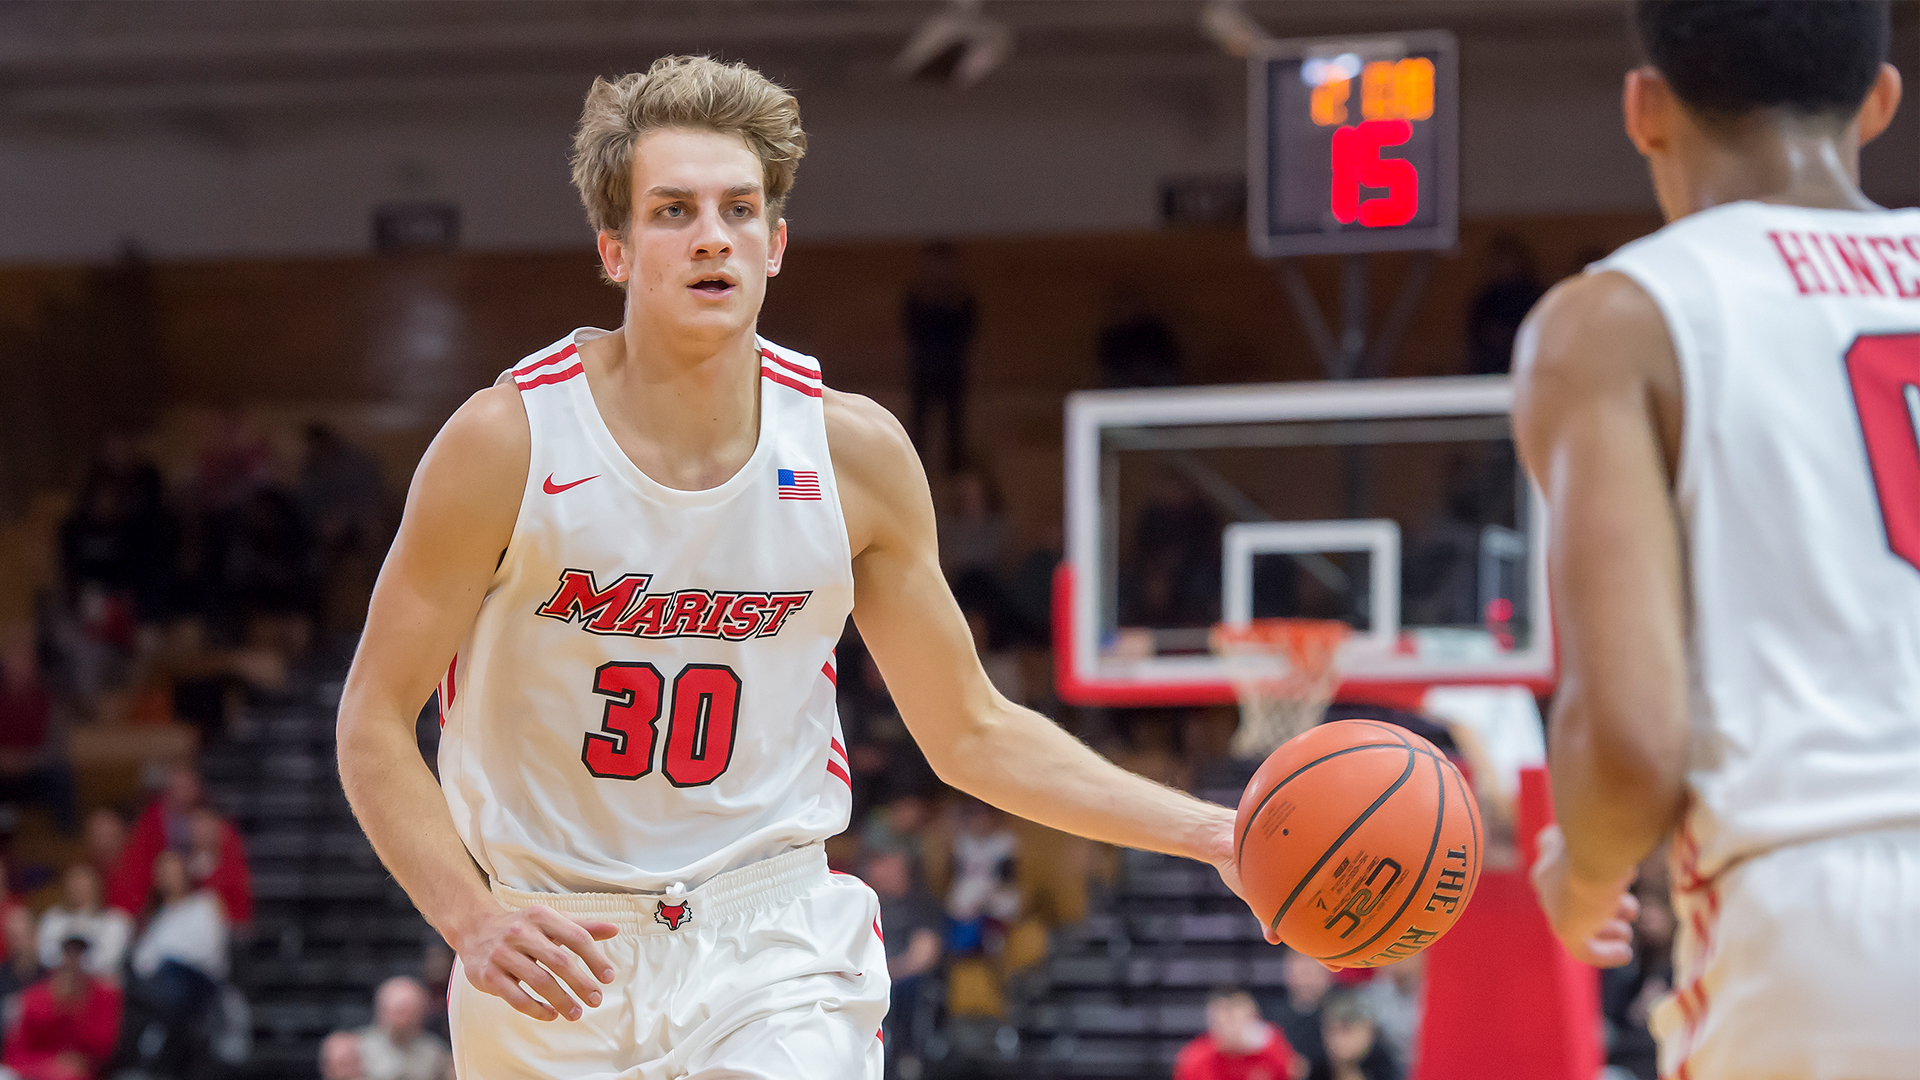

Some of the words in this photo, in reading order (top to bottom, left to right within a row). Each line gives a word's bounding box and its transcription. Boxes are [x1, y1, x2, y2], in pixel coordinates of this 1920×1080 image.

[1331, 118, 1419, 228] 15
[534, 567, 814, 642] MARIST
[580, 660, 743, 789] 30
[1323, 856, 1402, 940] C2C
[1424, 844, 1467, 915] THE
